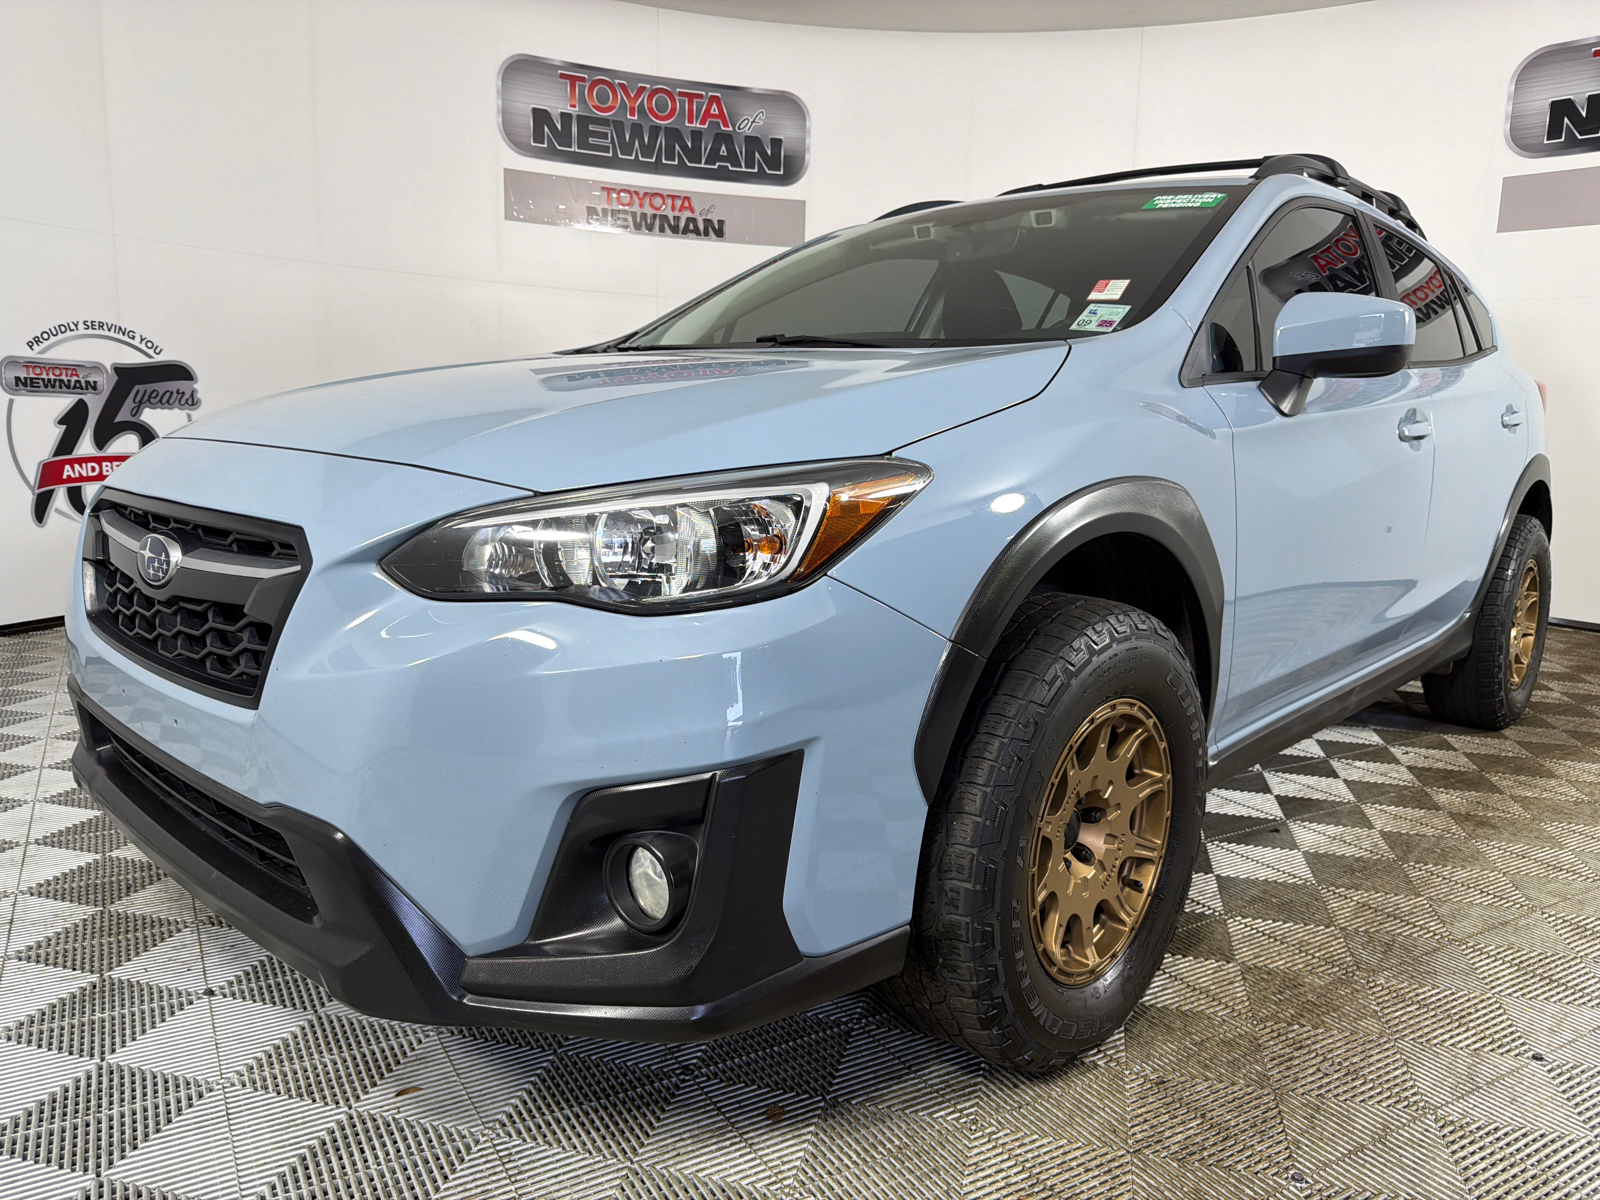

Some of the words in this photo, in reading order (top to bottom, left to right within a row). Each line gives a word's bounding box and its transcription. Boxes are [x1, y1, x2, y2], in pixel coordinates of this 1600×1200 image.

[558, 71, 732, 130] TOYOTA
[736, 110, 765, 133] of
[530, 106, 784, 175] NEWNAN
[600, 186, 696, 215] TOYOTA
[1154, 193, 1224, 201] PRE-DELIVERY
[585, 205, 726, 240] NEWNAN
[26, 321, 80, 351] PROUDLY
[83, 320, 136, 341] SERVING
[139, 334, 163, 356] YOU
[1076, 319, 1092, 327] 09
[1099, 320, 1114, 328] 25
[14, 376, 98, 391] NEWNAN
[22, 365, 80, 379] TOYOTA
[130, 387, 199, 418] years
[62, 464, 100, 479] AND
[1166, 667, 1205, 818] COOPER
[1011, 898, 1117, 1040] DISCOVERER
